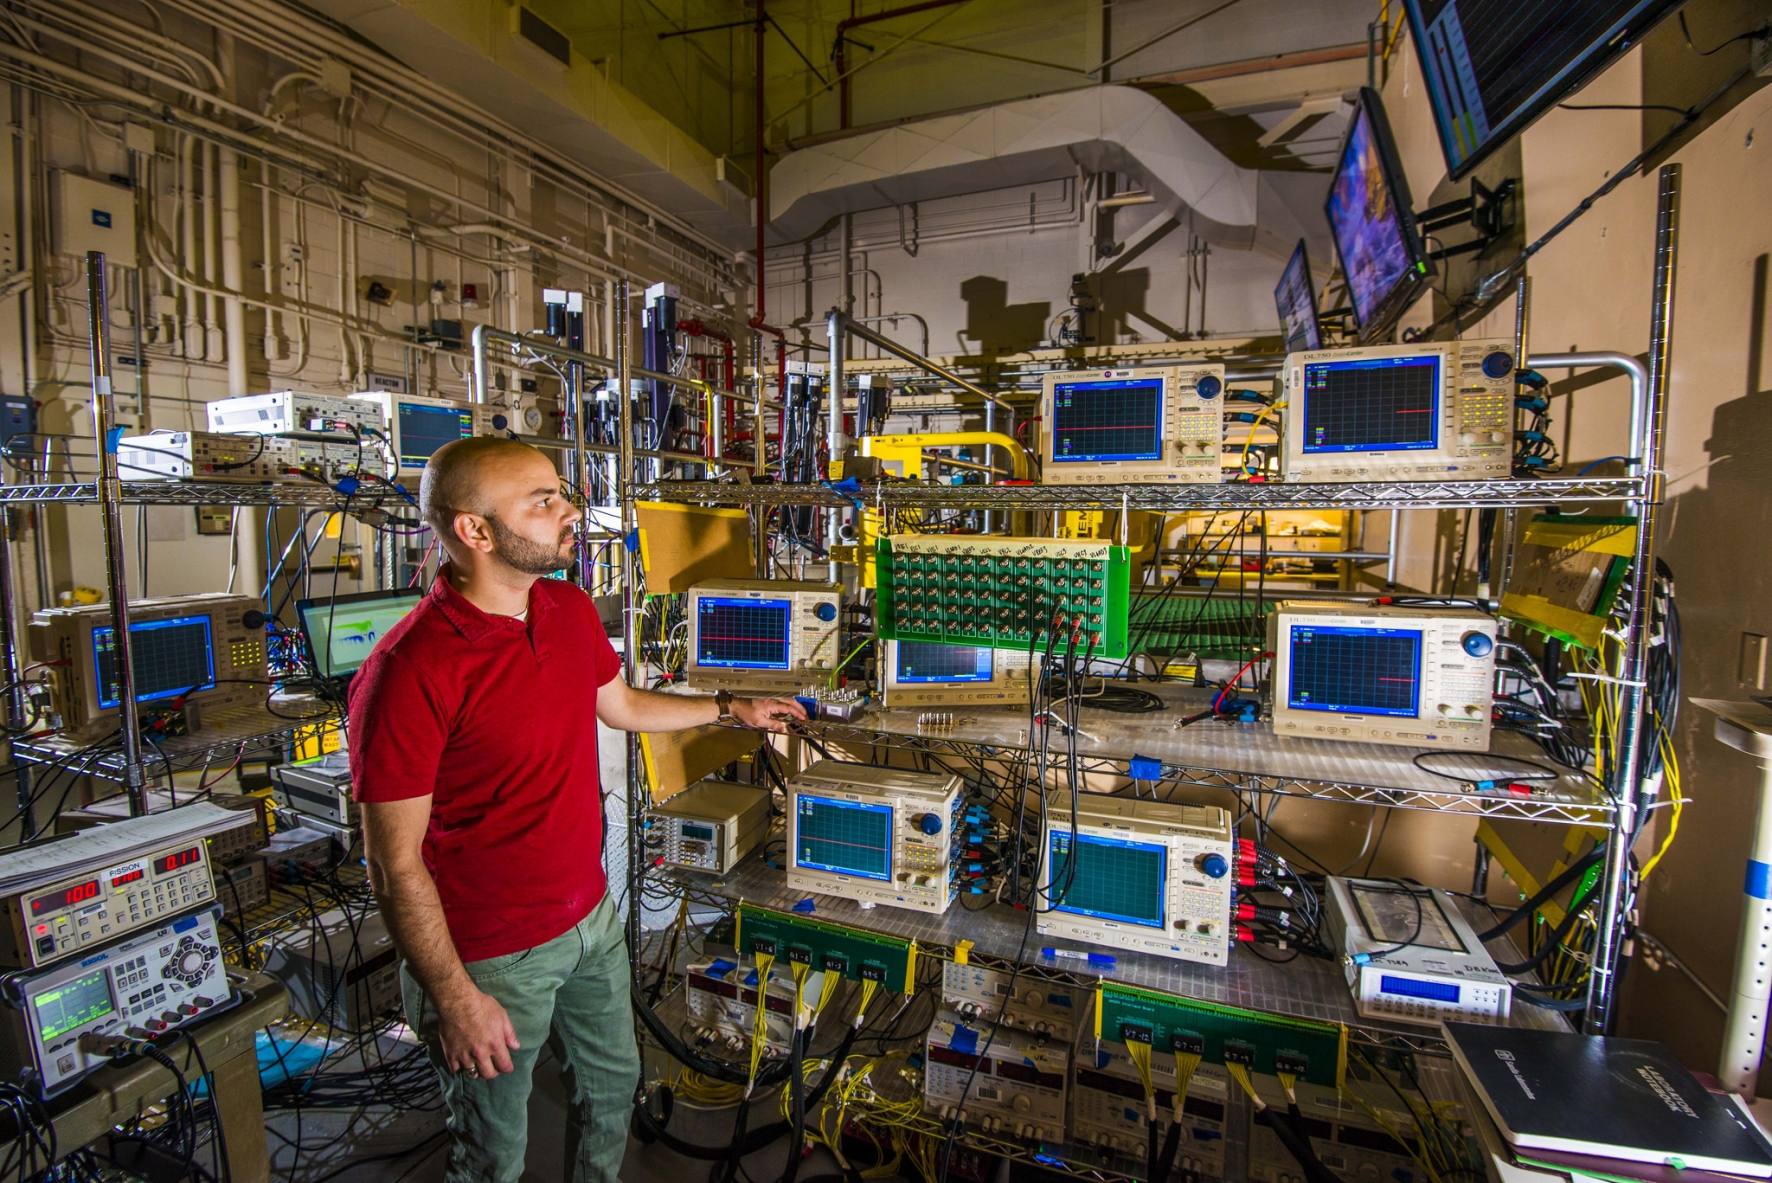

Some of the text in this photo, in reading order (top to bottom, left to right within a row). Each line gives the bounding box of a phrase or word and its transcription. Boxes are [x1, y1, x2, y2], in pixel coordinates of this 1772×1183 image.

[1303, 352, 1331, 360] DL750
[375, 377, 399, 388] REACTOR
[795, 787, 814, 795] DL750
[1048, 822, 1071, 831] DL750
[109, 862, 140, 877] FISSION
[62, 904, 76, 912] VOLTS
[81, 953, 108, 968] RIGOL
[1635, 1068, 1682, 1112] NOTEBOOK
[1643, 1065, 1700, 1119] LABORATORY
